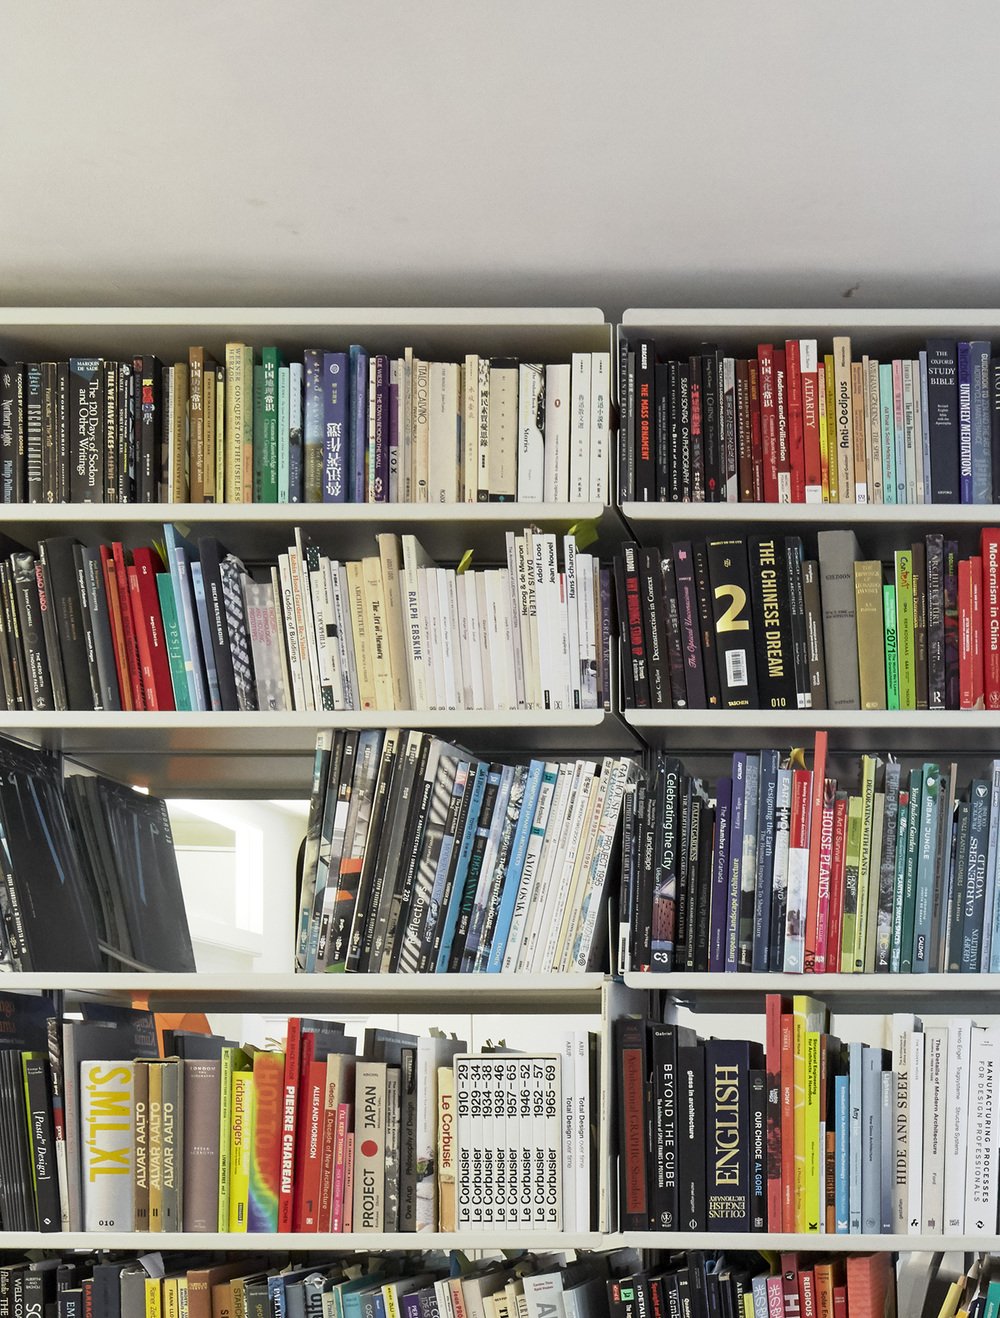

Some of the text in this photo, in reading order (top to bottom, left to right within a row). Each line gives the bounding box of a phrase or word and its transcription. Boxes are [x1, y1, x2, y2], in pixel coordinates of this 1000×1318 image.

[805, 378, 815, 428] ALTARITY
[961, 384, 971, 476] UNTIMELY MEDITATIONS
[77, 389, 88, 475] and Other Writings
[87, 379, 98, 486] The 120 Days of Sodom
[641, 421, 649, 460] ORNAMENT
[682, 428, 688, 438] ON
[681, 440, 689, 483] PHOTOGRAPHY
[35, 565, 47, 610] TADAO ANDO
[715, 585, 749, 633] 2
[759, 541, 783, 677] THE CHINESE DREAM
[989, 543, 999, 650] Modernism in China
[293, 594, 303, 623] Gardens:
[298, 626, 308, 660] Re-Visions
[409, 592, 422, 660] RALPH ERSKINE
[886, 629, 897, 653] 2071
[771, 699, 786, 707] 010
[662, 773, 676, 869] Celebrating the City
[819, 810, 833, 898] HOUSE PLANTS
[514, 853, 535, 918] KYOTO OSAKA
[233, 1079, 245, 1146] richard rogers
[281, 1086, 296, 1193] PIERRE CHAREAU
[664, 1064, 674, 1188] BEYOND THE CUBE
[715, 1064, 739, 1185] ENGLISH
[897, 1072, 908, 1185] HIDE AND SEEK
[136, 1103, 147, 1187] ALVAR AALTO
[151, 1103, 160, 1190] ALVAR AALTO
[164, 1103, 173, 1188] ALVAR AALTO
[363, 1086, 376, 1228] PROJECT JAPAN
[459, 1148, 469, 1205] Corbusier
[471, 1148, 481, 1205] Corbusier
[483, 1148, 493, 1205] Corbusier
[494, 1148, 504, 1205] Corbusier
[507, 1148, 518, 1205] Corbusier
[521, 1148, 531, 1205] Corbusier
[534, 1148, 544, 1205] Corbusier
[547, 1148, 557, 1205] Corbusier
[459, 1208, 469, 1222] Le
[471, 1208, 481, 1222] Le
[483, 1208, 493, 1222] Le
[494, 1208, 504, 1222] Le
[507, 1208, 518, 1222] Le
[521, 1208, 531, 1222] Le
[534, 1208, 544, 1222] Le
[547, 1208, 557, 1222] Le
